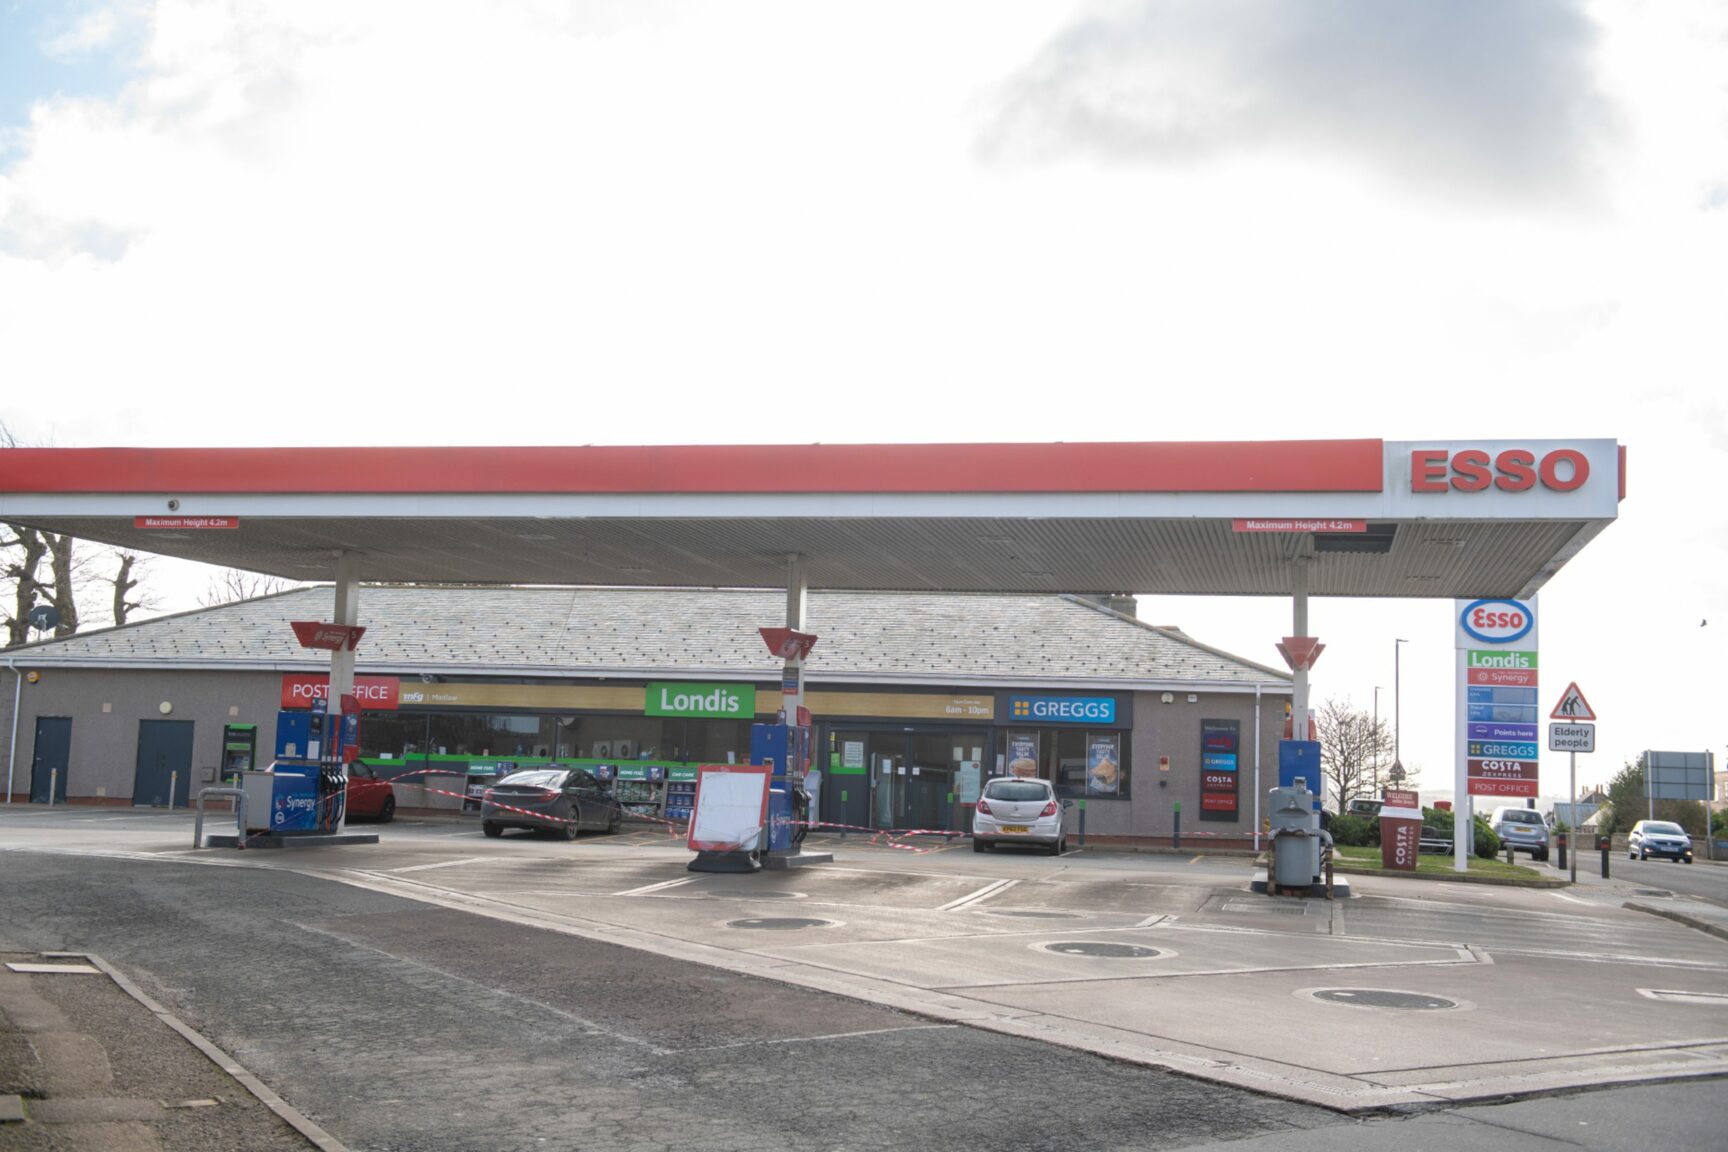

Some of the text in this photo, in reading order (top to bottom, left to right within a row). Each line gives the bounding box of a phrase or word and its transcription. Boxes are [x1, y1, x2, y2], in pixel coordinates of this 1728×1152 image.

[1411, 449, 1590, 493] ESSO
[145, 518, 228, 528] Maximum Height 4.2m
[1246, 521, 1353, 531] Maximum Height 4.2m
[1473, 608, 1523, 629] Esso
[1472, 652, 1529, 668] Londis
[1491, 672, 1529, 684] Synergy
[292, 683, 332, 698] POST
[661, 688, 740, 712] Londis
[945, 705, 962, 714] 6am
[968, 705, 989, 715] 10pm
[1033, 701, 1110, 718] GREGGS
[1554, 727, 1590, 737] Elderly
[1554, 739, 1590, 748] people
[1483, 744, 1535, 756] GREGGS
[1482, 761, 1521, 771] COSTA
[1206, 776, 1232, 784] COSTA
[1475, 783, 1529, 792] POST OFFICE
[286, 795, 316, 812] Synergy
[1395, 826, 1408, 865] COSTA
